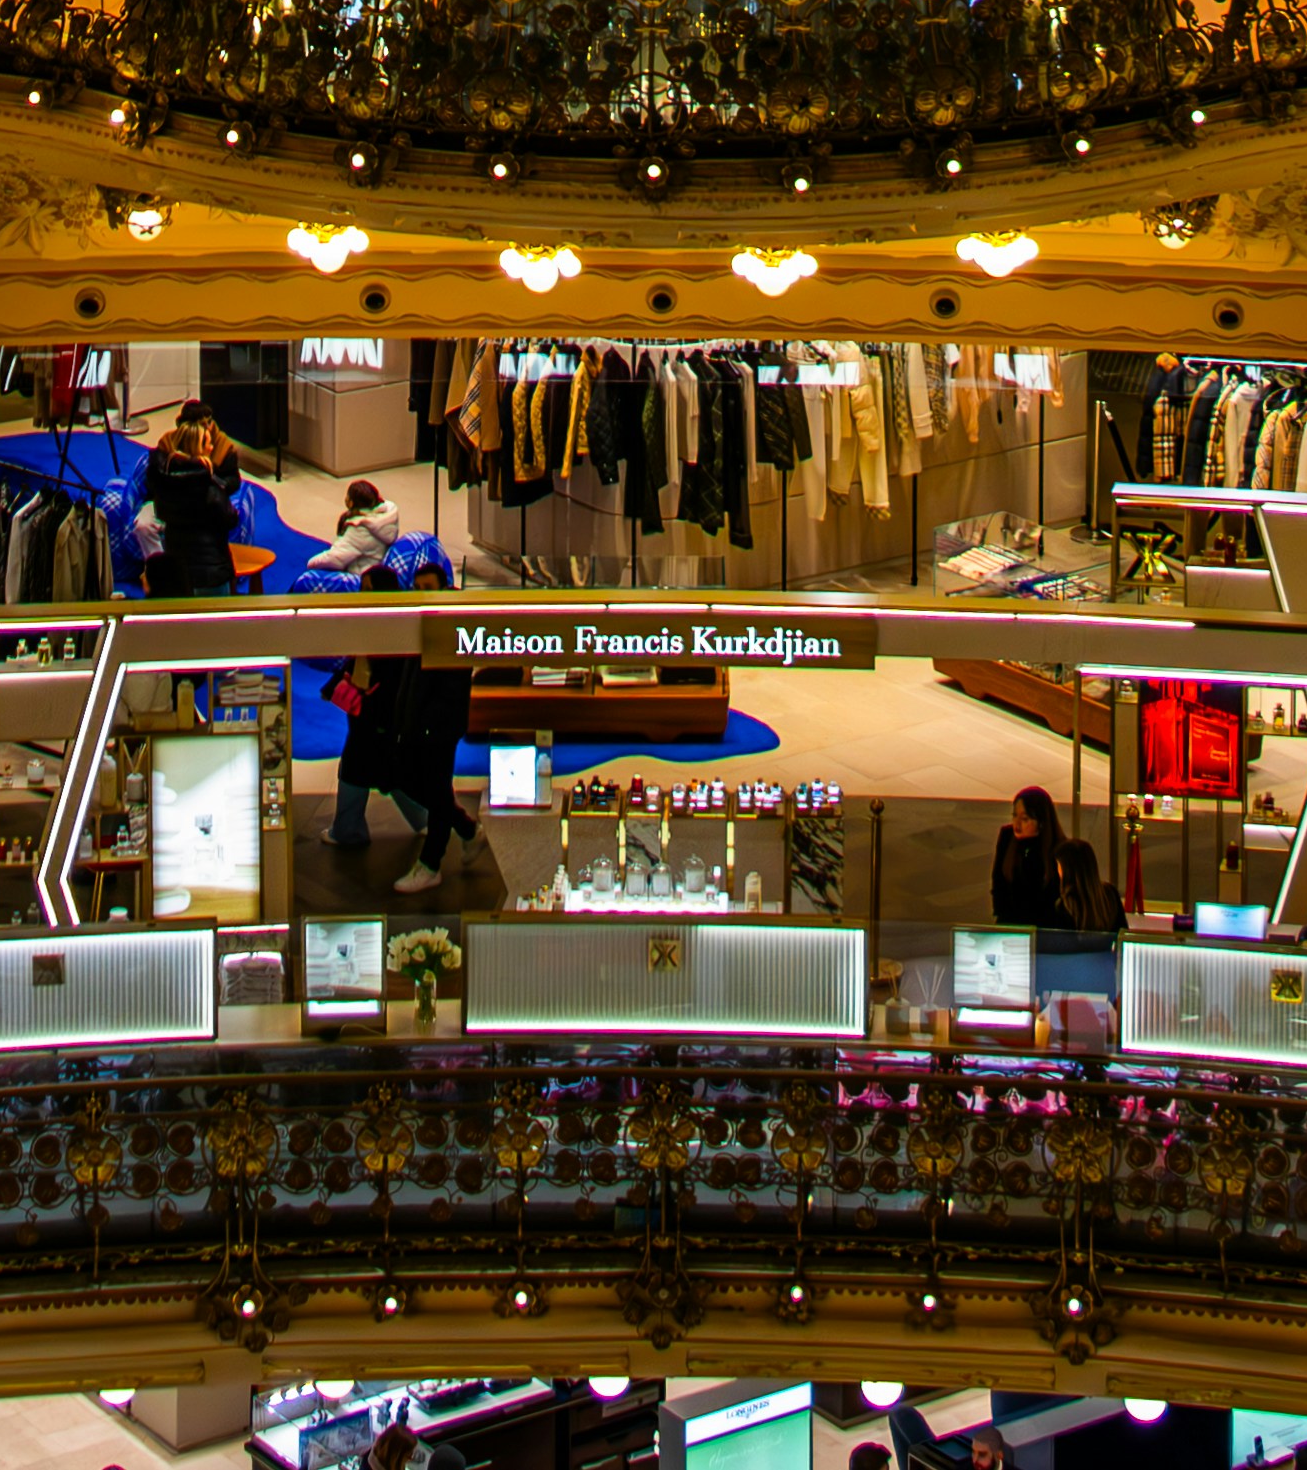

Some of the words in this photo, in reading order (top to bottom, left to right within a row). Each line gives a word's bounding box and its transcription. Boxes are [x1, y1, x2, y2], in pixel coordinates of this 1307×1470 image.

[456, 626, 564, 655] Maison
[574, 625, 684, 656] Francis
[691, 625, 842, 666] Kurkdjian
[725, 1399, 770, 1420] LONGINES
